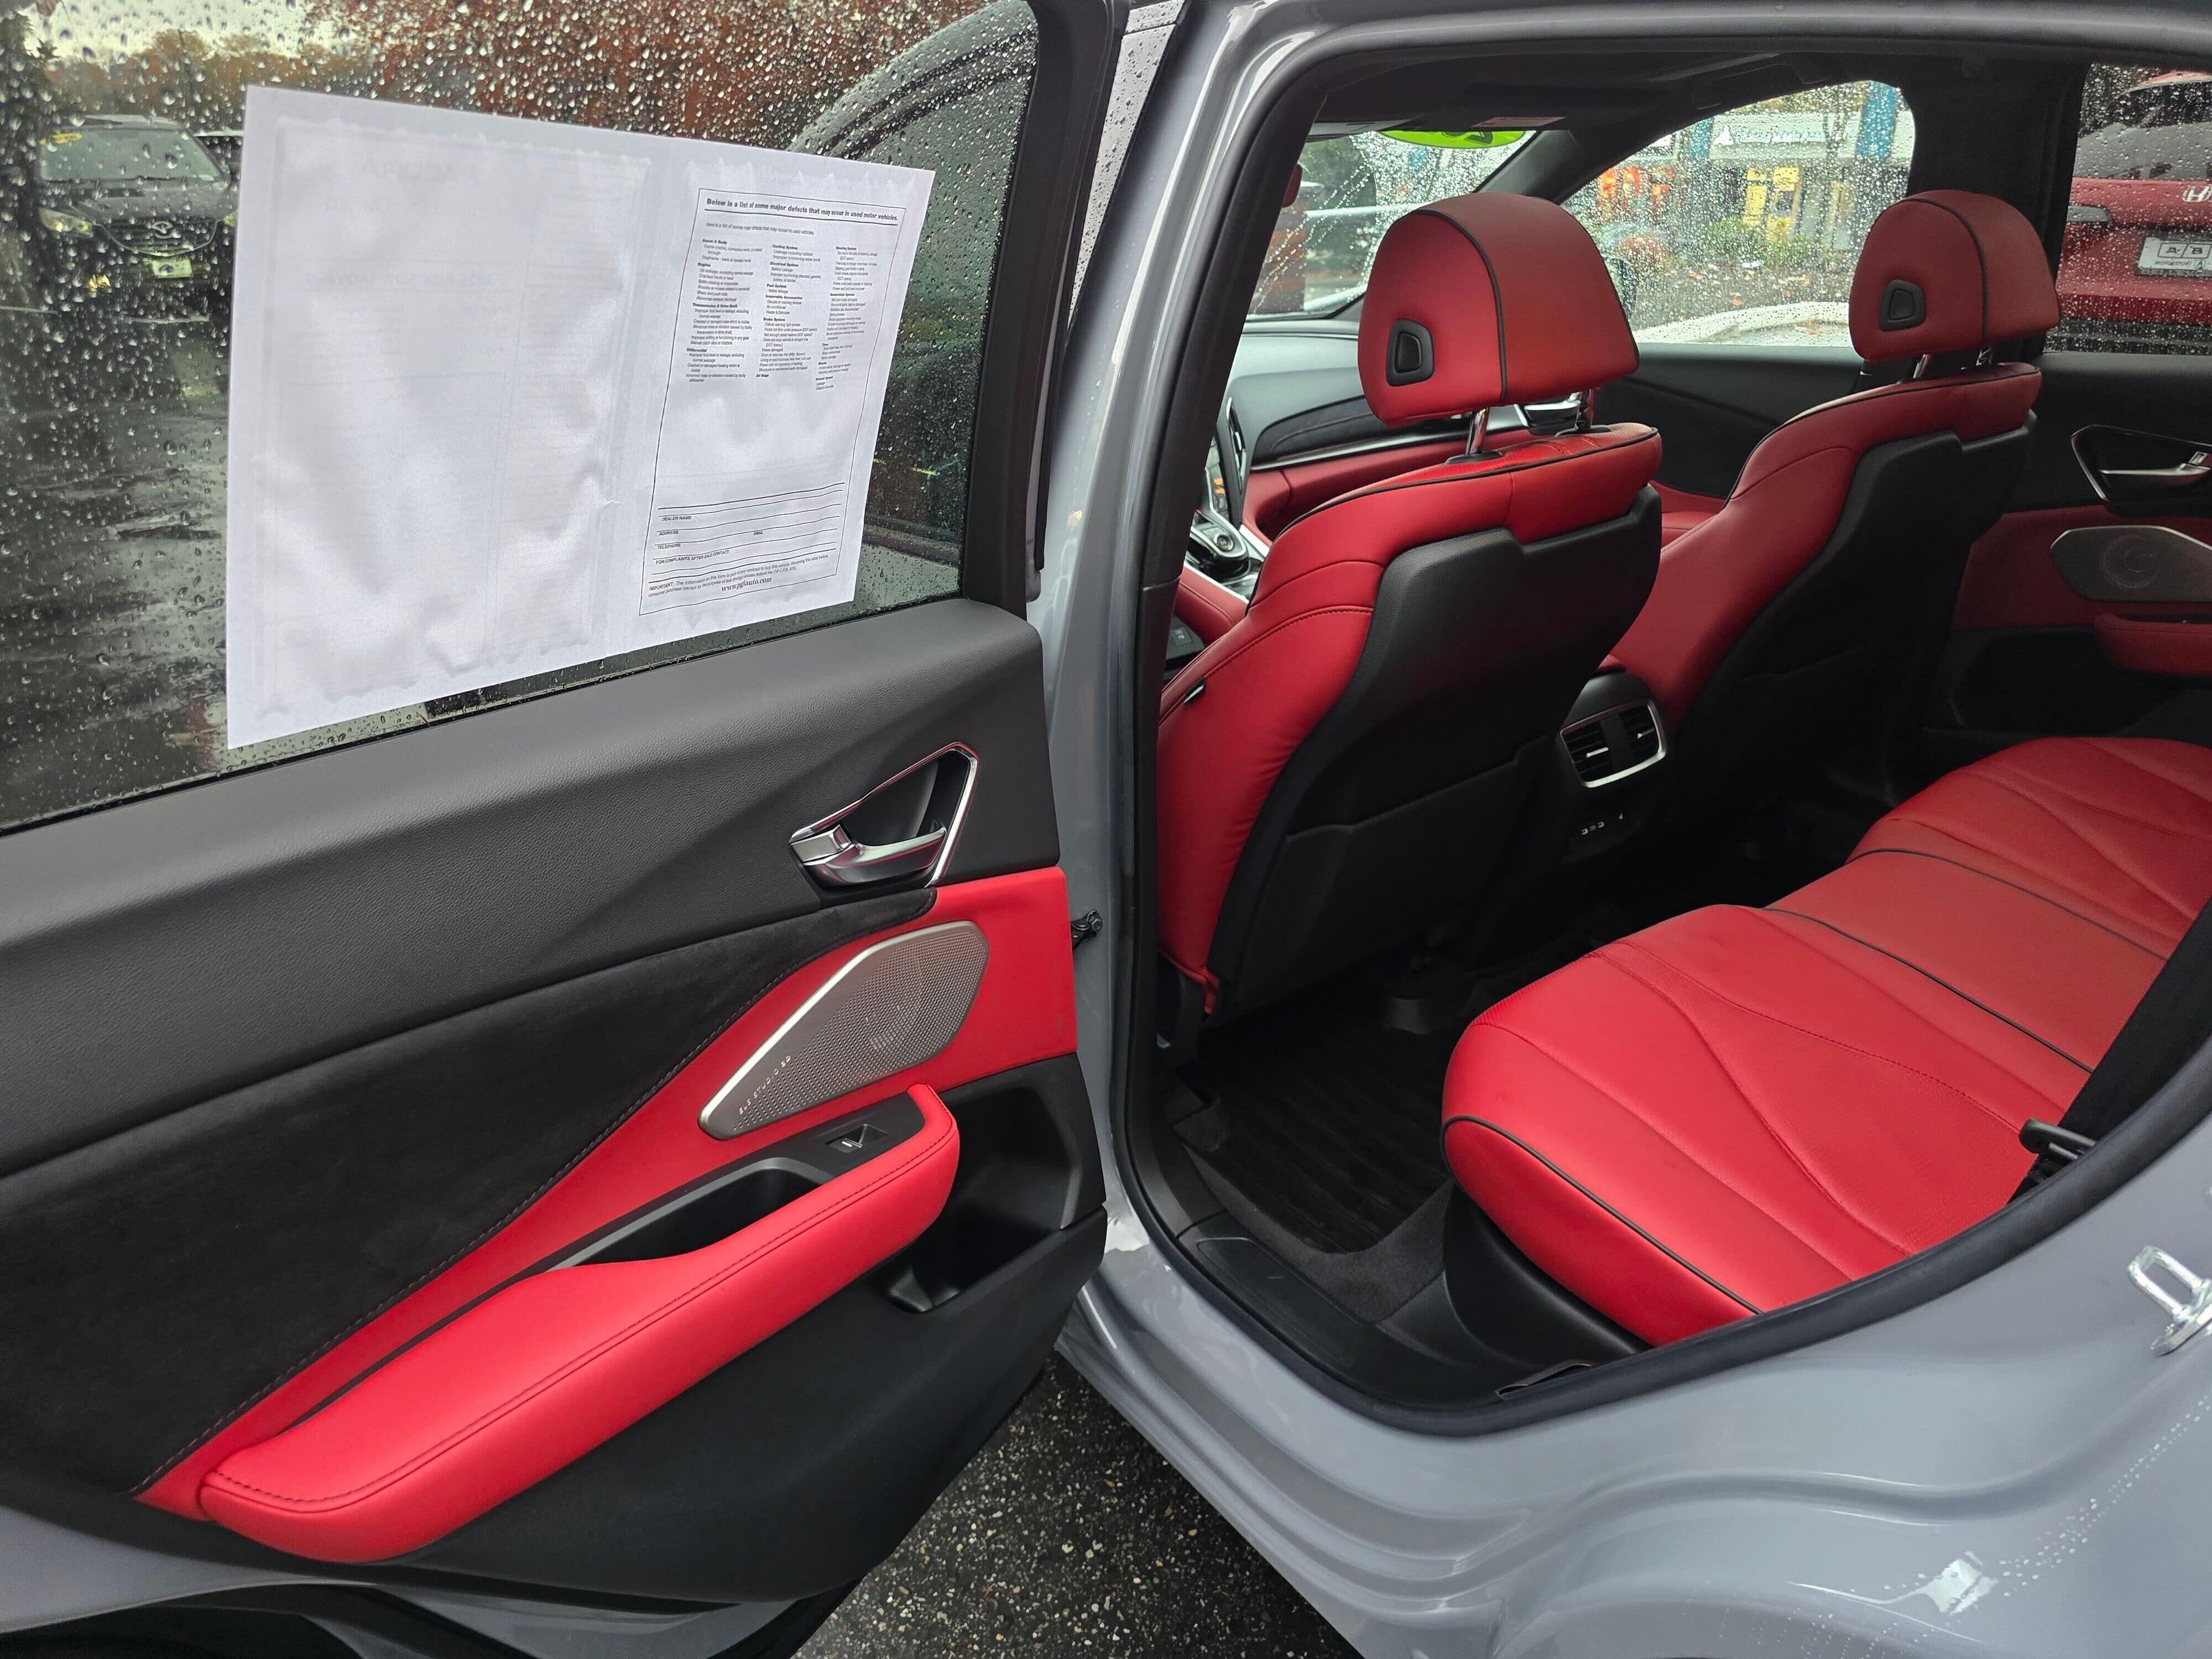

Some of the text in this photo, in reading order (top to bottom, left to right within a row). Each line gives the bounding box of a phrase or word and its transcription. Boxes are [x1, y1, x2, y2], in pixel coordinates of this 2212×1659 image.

[788, 205, 807, 213] defects
[649, 582, 674, 591] IMPORTANT:
[739, 1098, 751, 1115] ELS
[753, 1068, 779, 1098] STUDIO
